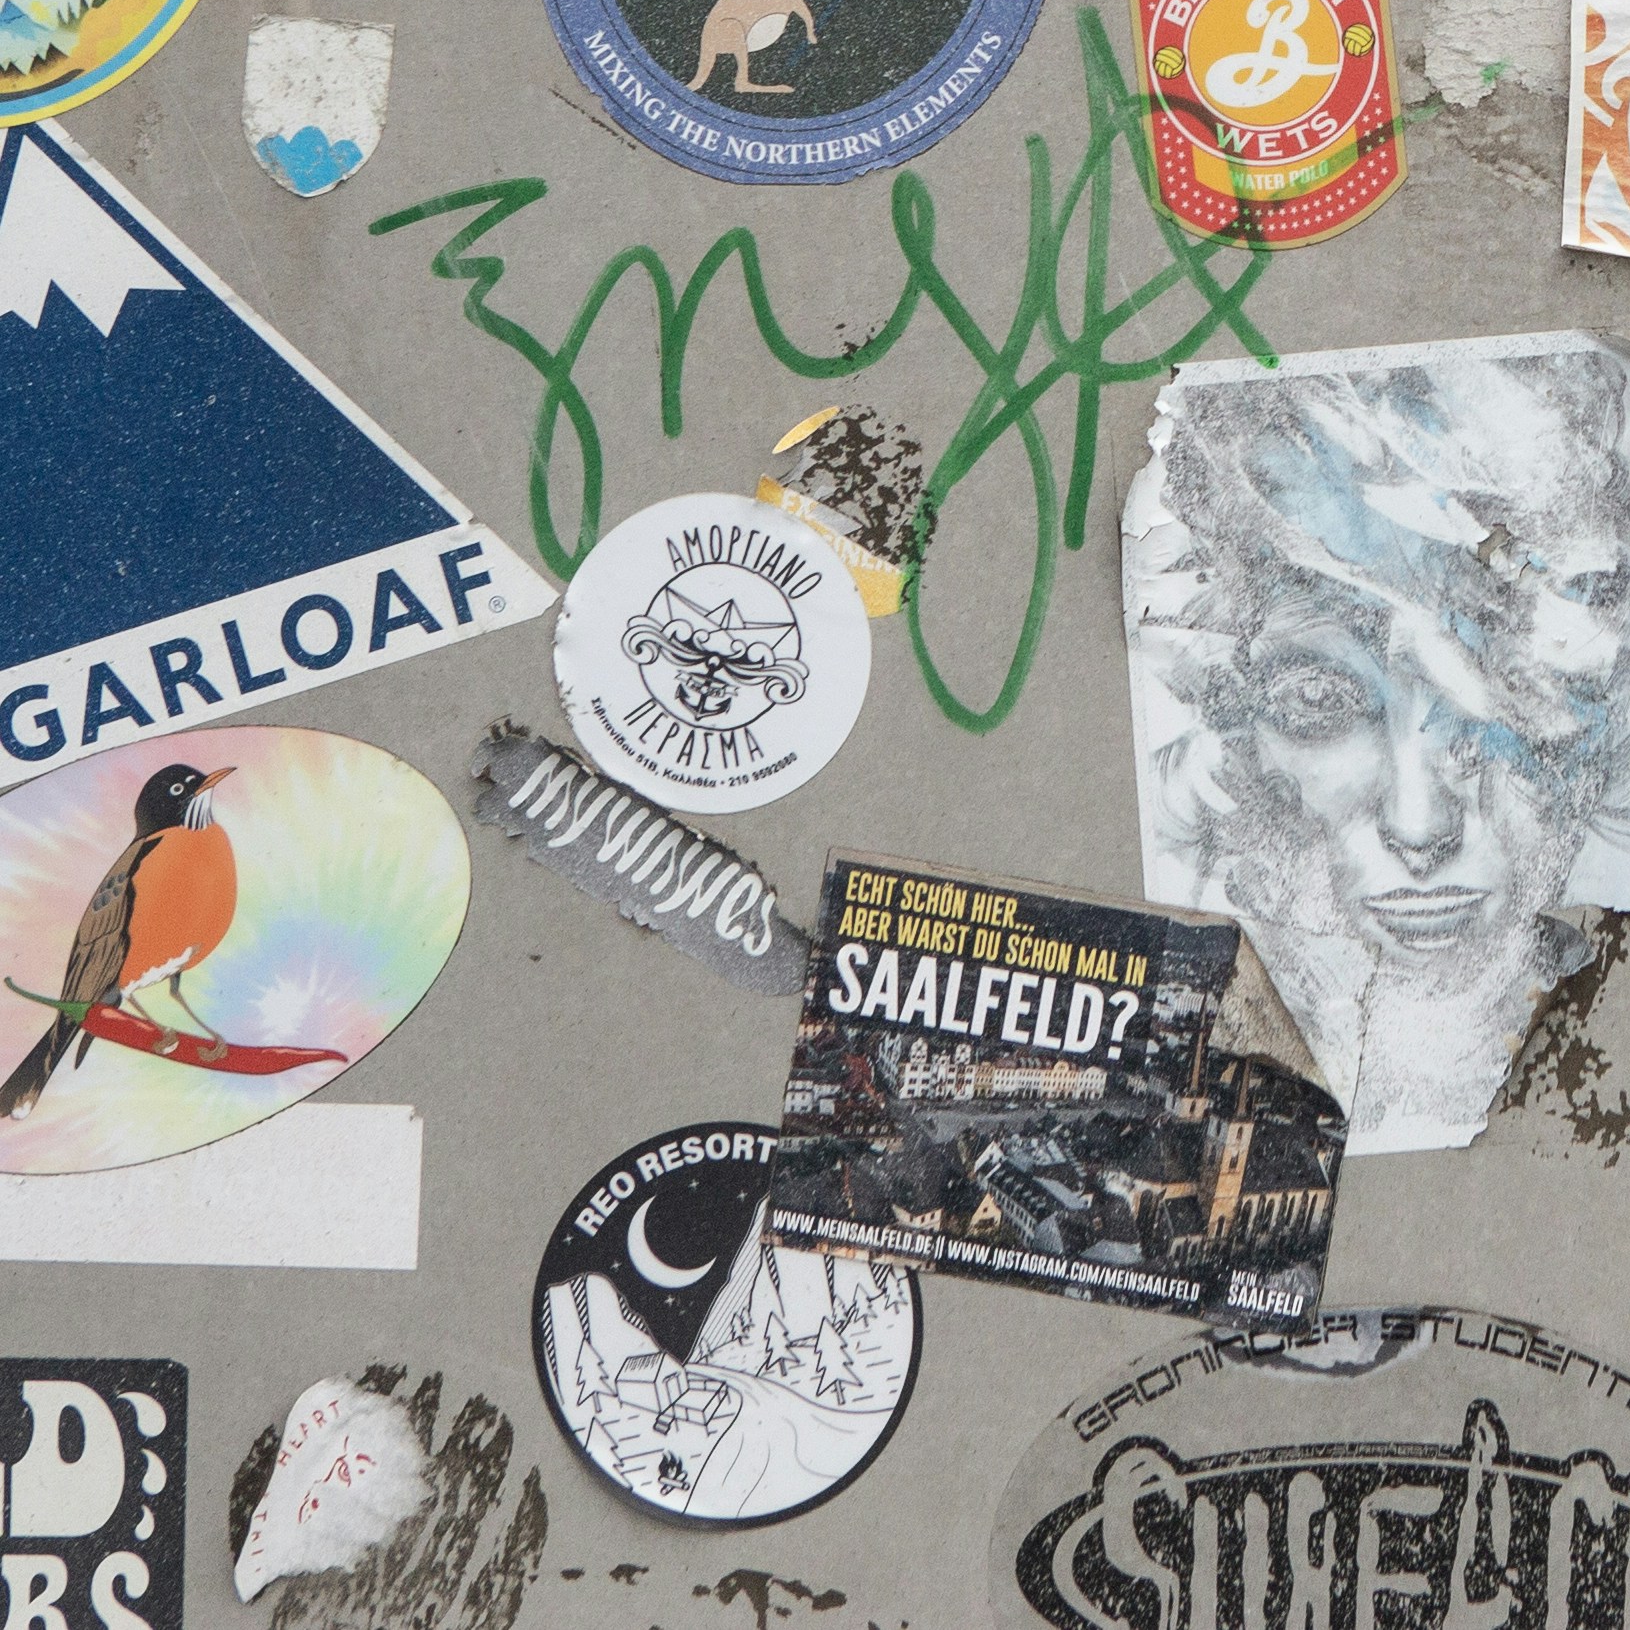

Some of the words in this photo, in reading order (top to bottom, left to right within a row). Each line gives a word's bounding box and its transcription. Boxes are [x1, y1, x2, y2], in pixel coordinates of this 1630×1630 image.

[583, 29, 664, 122] MIXING
[667, 108, 721, 152] THE
[724, 126, 883, 165] NORTHERN
[883, 29, 1003, 143] ELEMENTS
[1216, 110, 1339, 158] WETS
[1232, 173, 1285, 192] WATER
[1290, 159, 1330, 183] POLO
[846, 870, 898, 906] ECHT
[902, 880, 968, 918] SCHÖN
[838, 905, 891, 943] ABER
[897, 913, 969, 954] WARST
[972, 930, 1002, 959] DU
[1006, 936, 1072, 972] SCHON
[1075, 948, 1120, 982] MAL
[1125, 956, 1146, 987] IN
[829, 942, 1142, 1060] SAALFELD?
[573, 1171, 637, 1238] REO
[637, 1133, 779, 1184] RESORT
[771, 1210, 933, 1255] WWW.MEINSAALFELD.DE
[1227, 1283, 1305, 1318] SAALFELD
[278, 1400, 341, 1467] HEART
